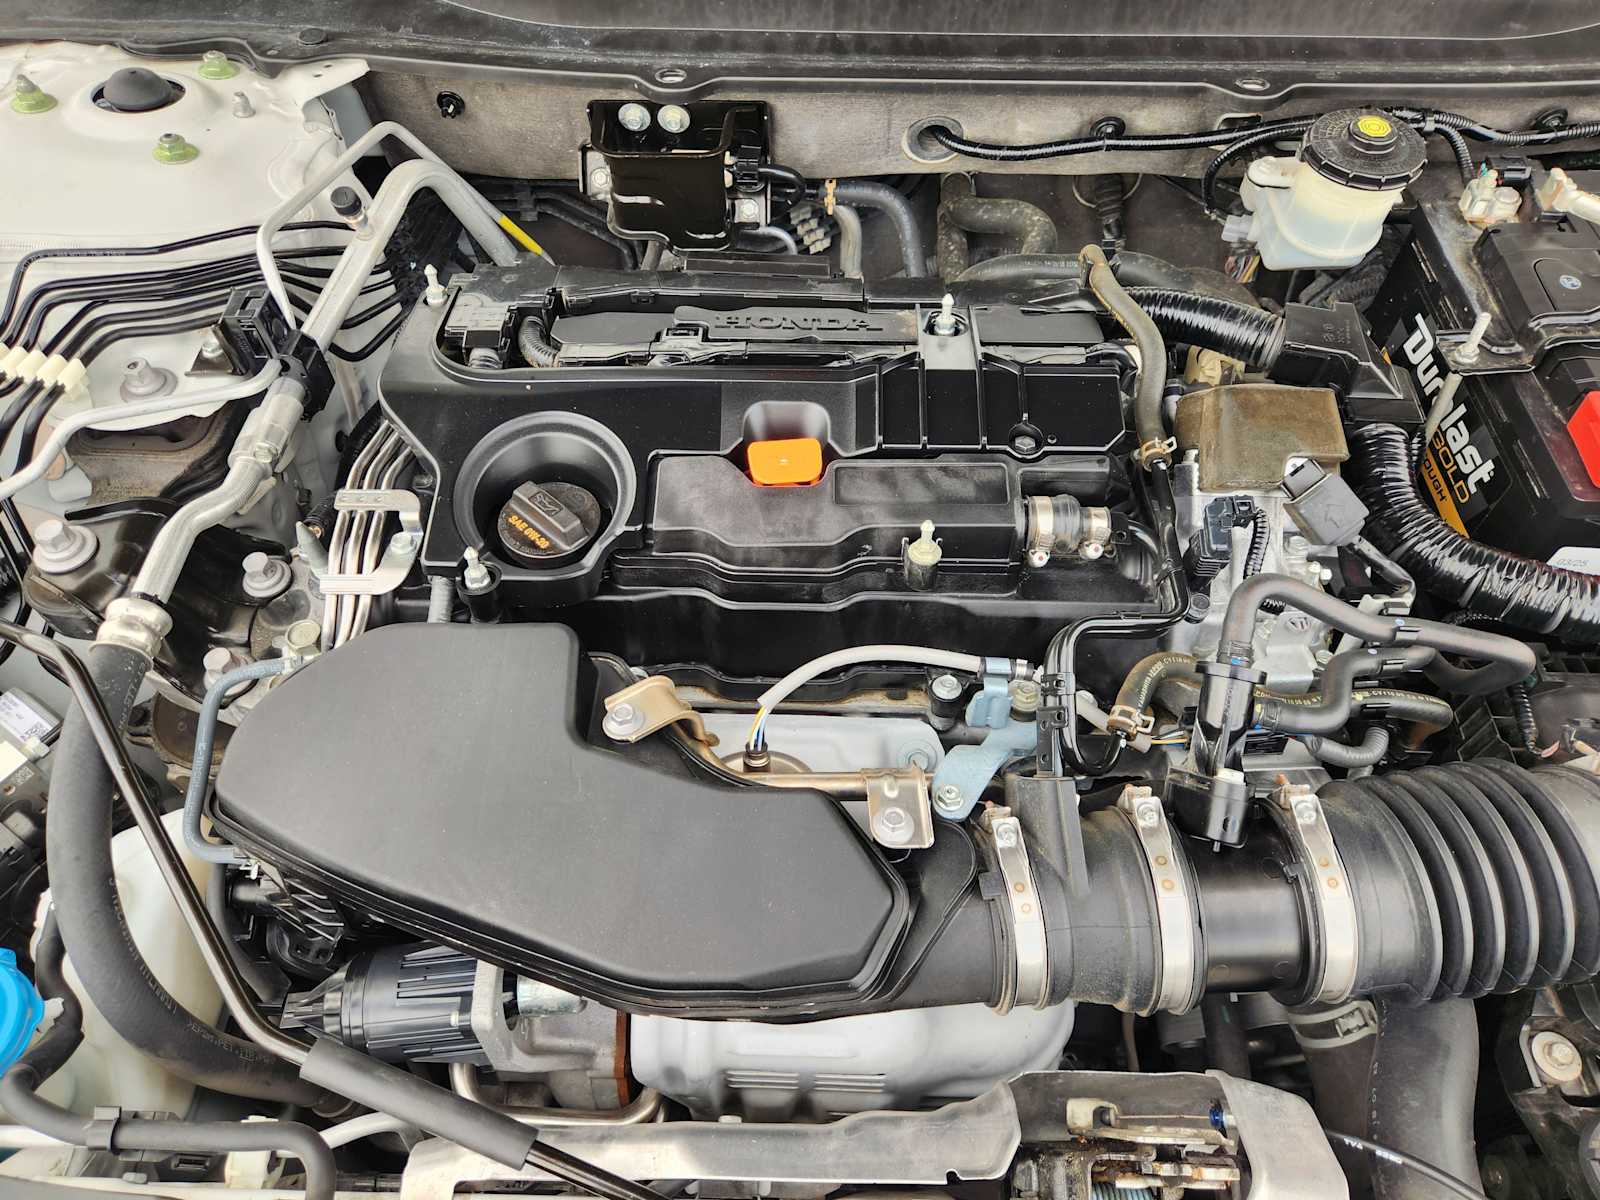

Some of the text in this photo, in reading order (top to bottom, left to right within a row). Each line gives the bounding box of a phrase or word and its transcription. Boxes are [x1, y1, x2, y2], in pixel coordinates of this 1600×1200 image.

[713, 316, 884, 331] HONDA
[1402, 312, 1495, 495] Durlast
[1423, 453, 1447, 502] OUGH
[507, 515, 529, 532] SAE
[523, 527, 551, 550] 0W-20
